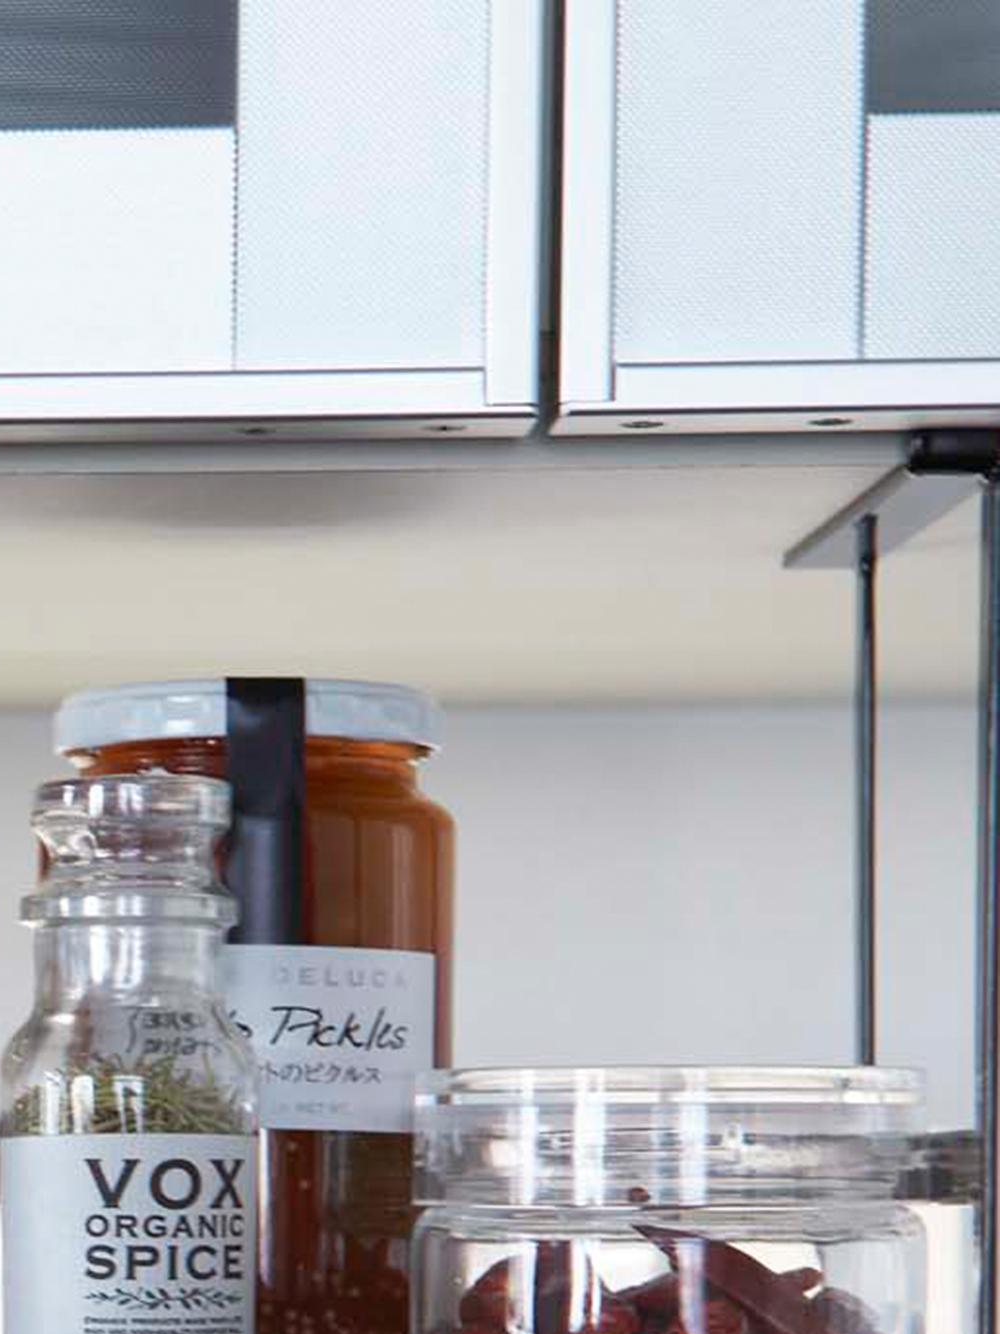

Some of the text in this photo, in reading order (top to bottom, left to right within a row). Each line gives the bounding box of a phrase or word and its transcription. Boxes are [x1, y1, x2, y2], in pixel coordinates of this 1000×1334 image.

[270, 1006, 408, 1050] Pickles
[84, 1159, 245, 1210] VOX
[85, 1214, 245, 1239] ORGANIC
[85, 1244, 244, 1281] SPICE
